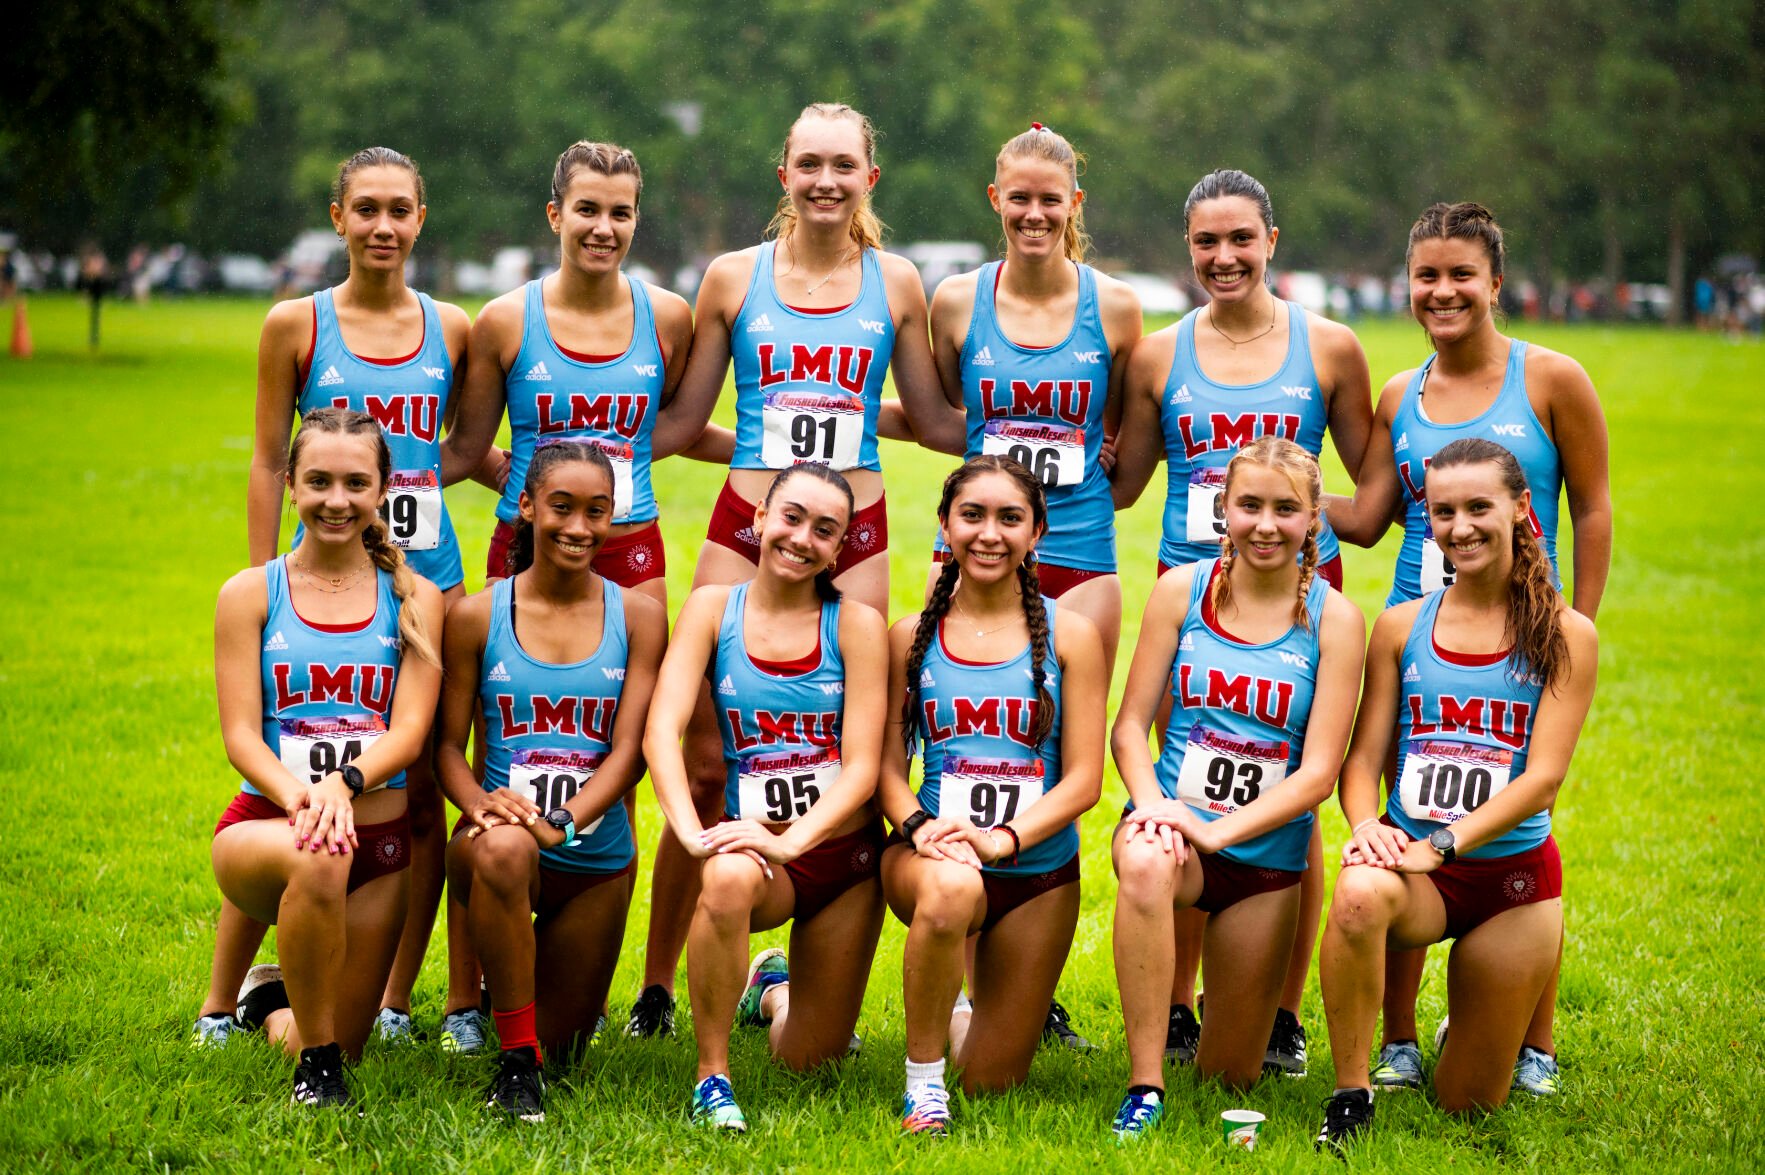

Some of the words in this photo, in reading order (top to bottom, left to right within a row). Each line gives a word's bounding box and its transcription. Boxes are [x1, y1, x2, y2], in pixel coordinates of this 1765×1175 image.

[317, 377, 344, 387] adidas
[525, 373, 552, 381] adidas
[758, 343, 873, 396] LMU
[535, 393, 649, 439] LMU
[979, 378, 1093, 426] LMU
[791, 414, 837, 459] 91
[735, 531, 760, 546] adida
[273, 663, 394, 714] LMU
[1179, 663, 1294, 729] LMU
[496, 694, 616, 744] LMU
[727, 708, 837, 751] LMU
[924, 696, 1041, 749] LMU
[1408, 694, 1532, 750] LMU
[530, 774, 591, 817] 10
[764, 773, 821, 821] 95
[1204, 757, 1263, 806] 93
[1417, 763, 1492, 813] 100
[970, 783, 1020, 829] 97
